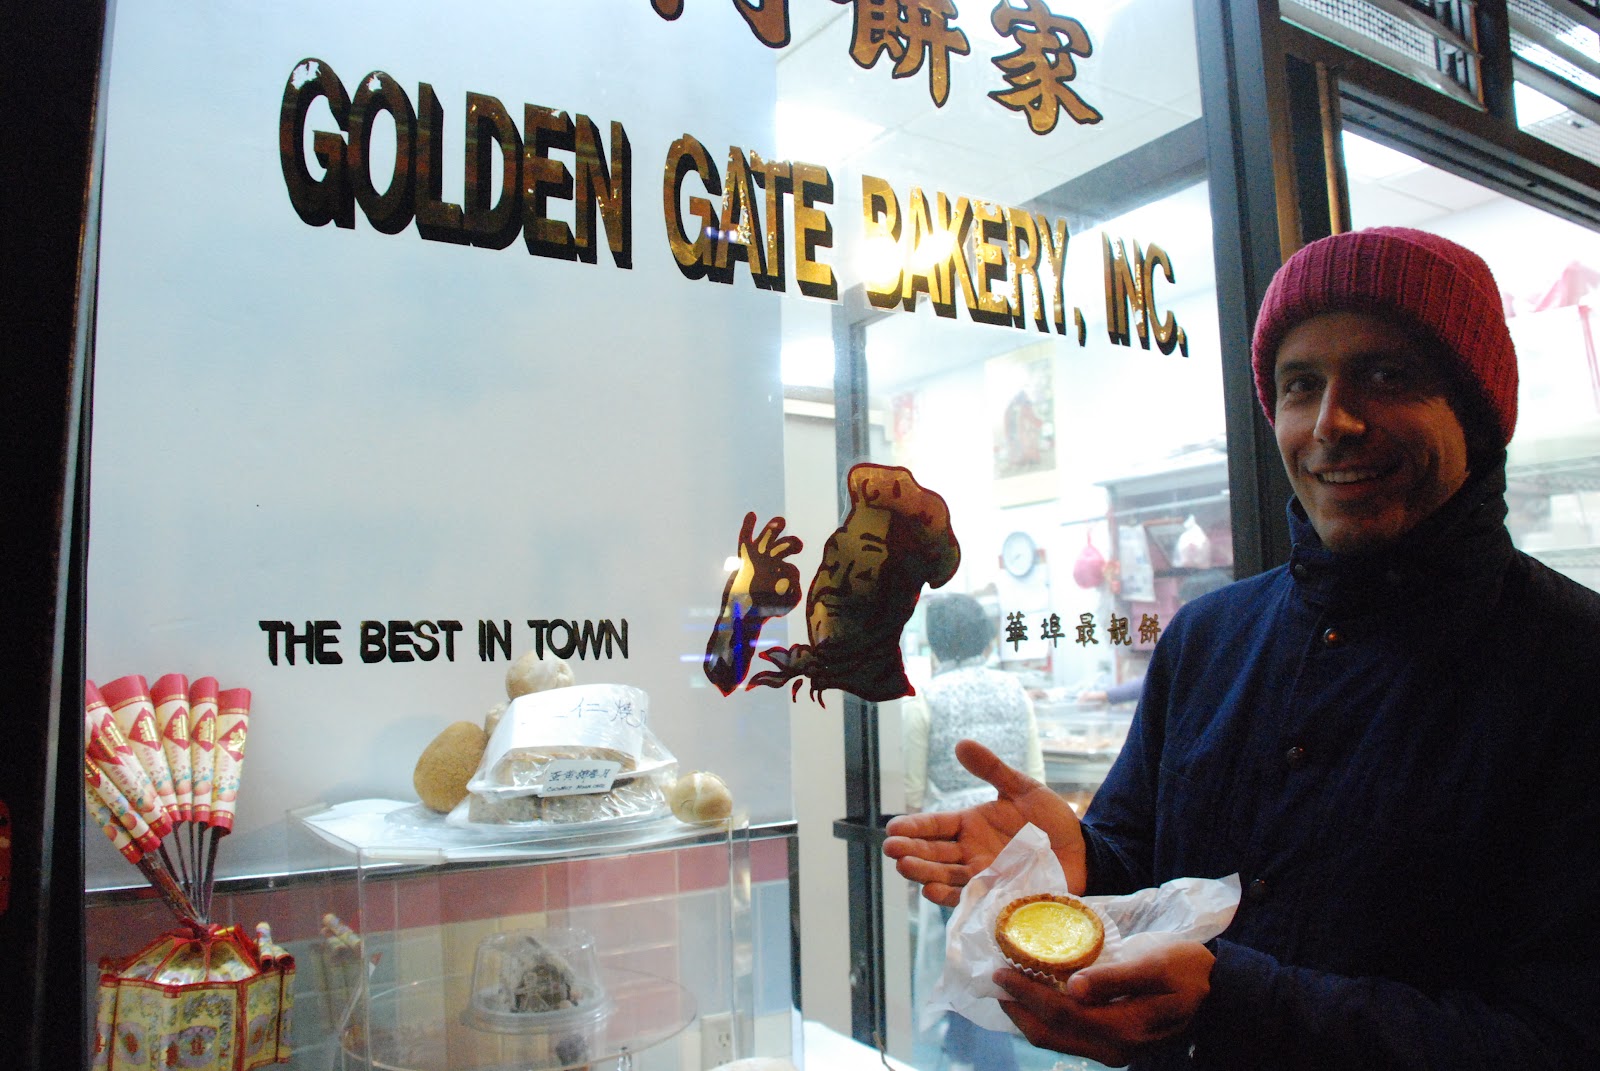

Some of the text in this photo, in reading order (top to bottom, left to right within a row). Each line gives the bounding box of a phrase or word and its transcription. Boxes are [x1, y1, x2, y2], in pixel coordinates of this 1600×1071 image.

[650, 0, 1103, 135] 餅家
[279, 57, 1189, 358] GOLDEN GATE BAKERY, INC.
[259, 618, 629, 666] THE BEST IN TOWN
